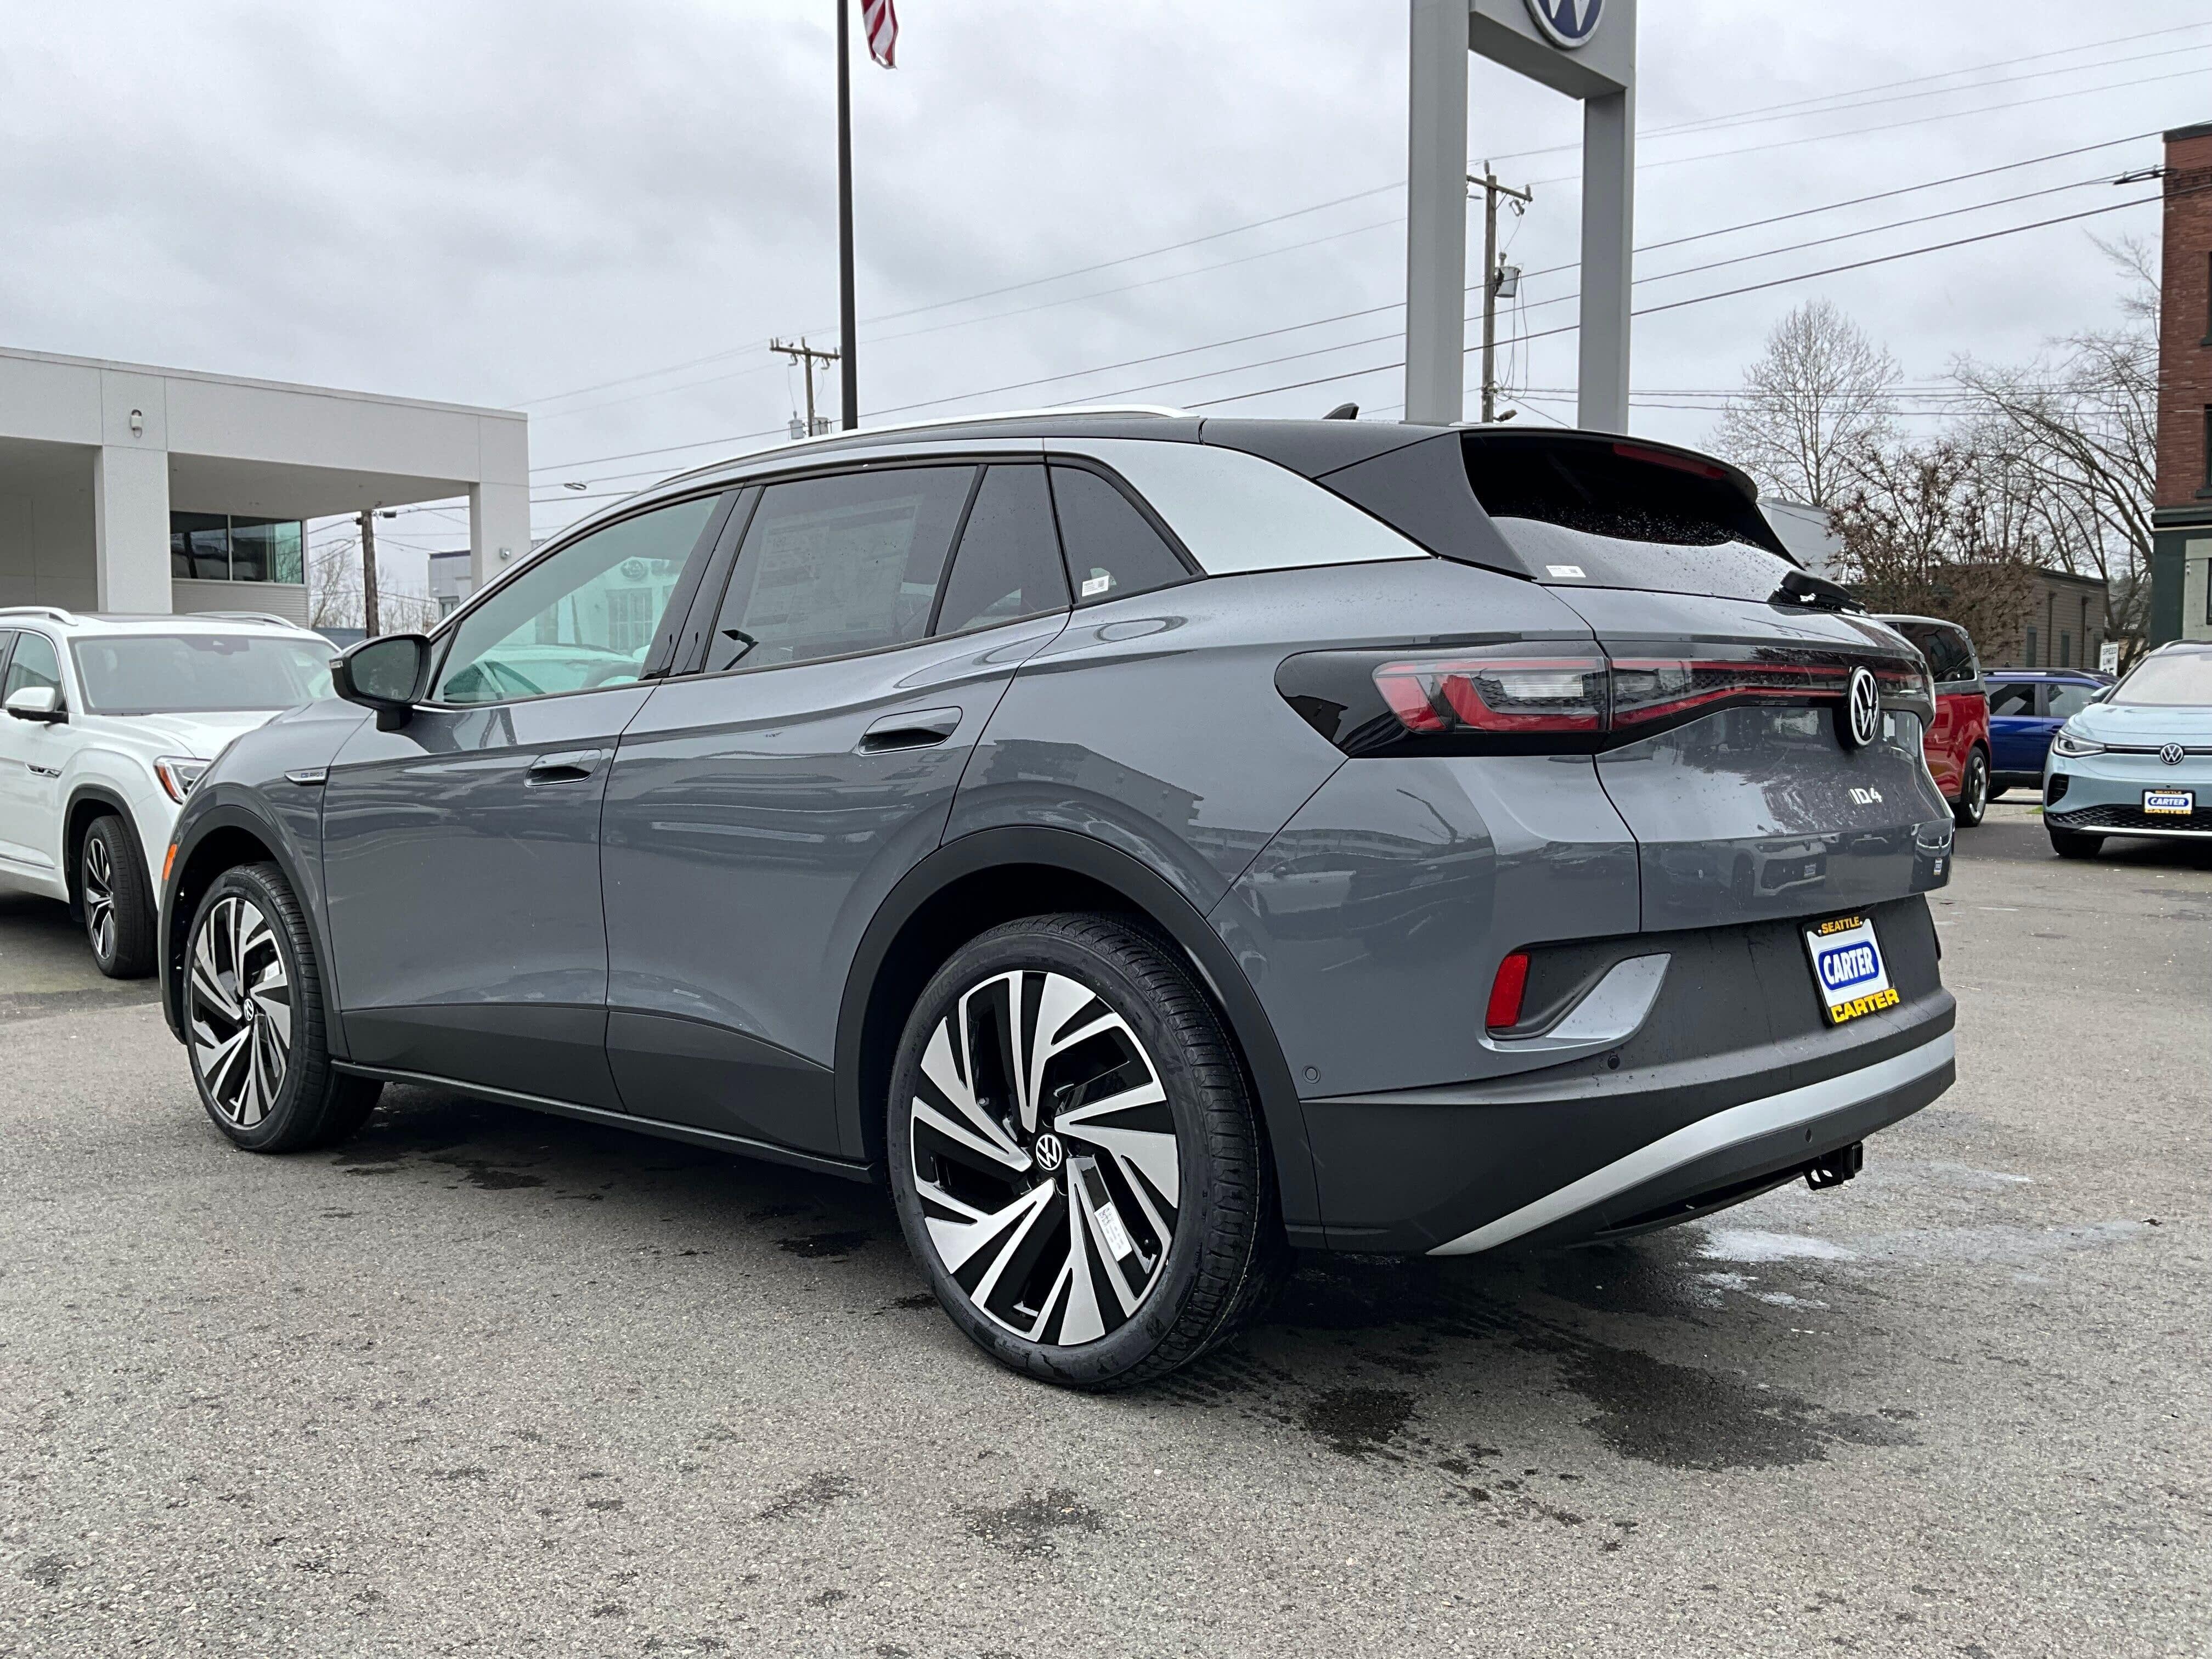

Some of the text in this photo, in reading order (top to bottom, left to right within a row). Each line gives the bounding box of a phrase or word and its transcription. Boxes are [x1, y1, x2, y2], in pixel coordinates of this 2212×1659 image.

[2151, 798, 2185, 806] CARTER
[1821, 916, 1860, 934] SEATTLE
[1823, 946, 1875, 985] CARTER
[1831, 989, 1900, 1023] CARTER
